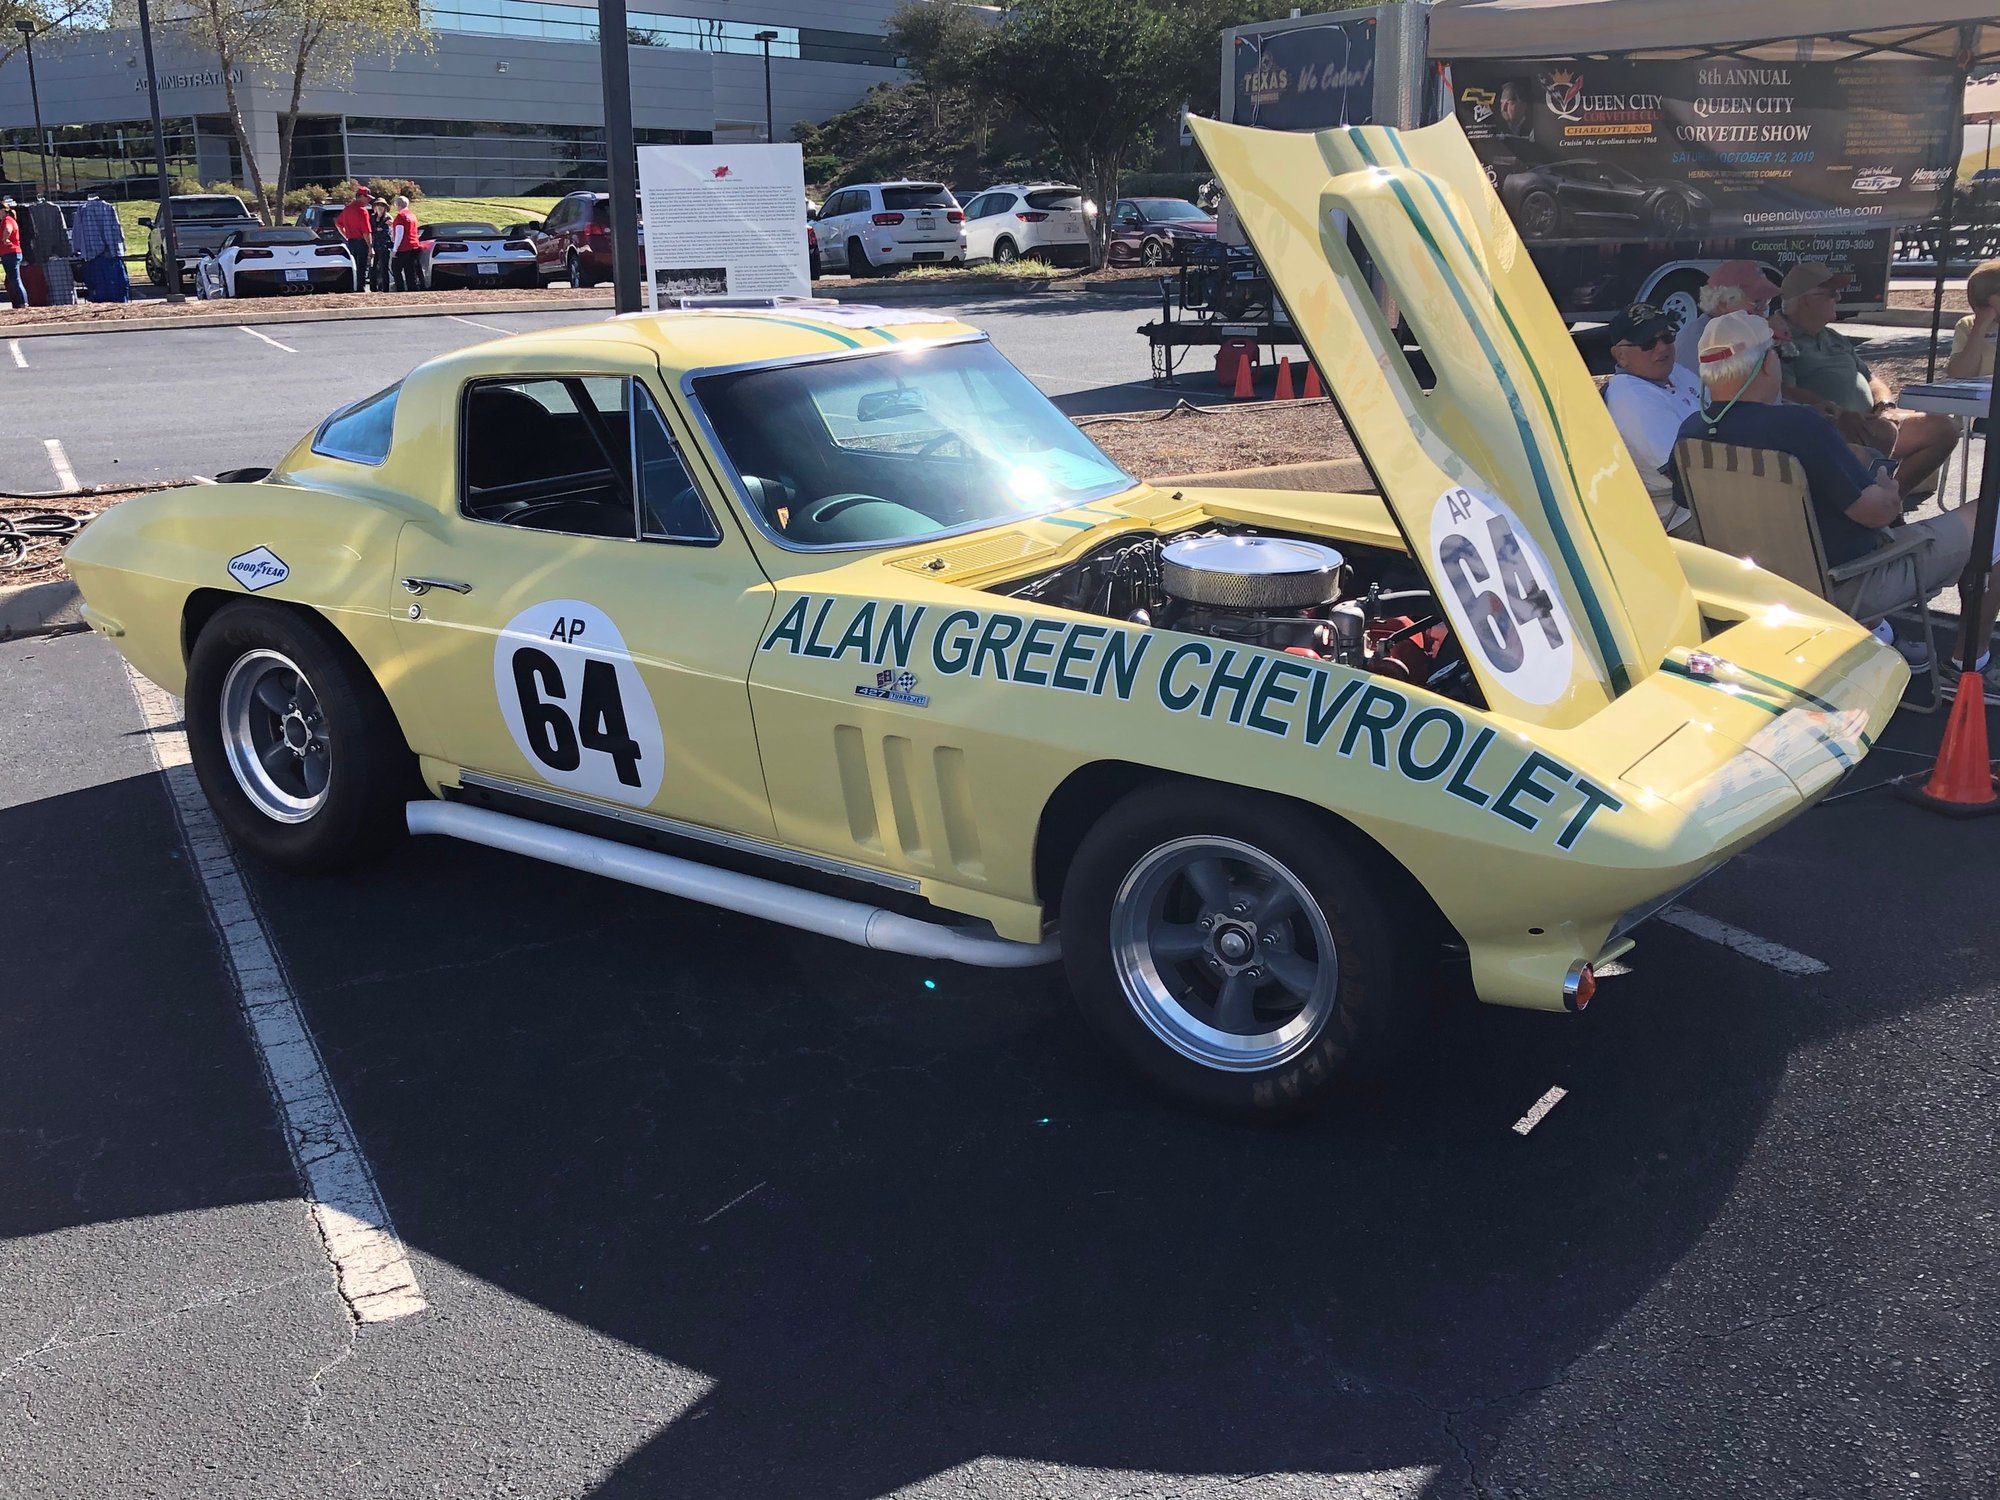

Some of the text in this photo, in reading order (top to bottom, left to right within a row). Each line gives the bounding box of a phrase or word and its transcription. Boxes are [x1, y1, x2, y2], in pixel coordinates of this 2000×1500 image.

[135, 69, 243, 91] ADINISTRATIN
[1244, 70, 1288, 93] TEXAS
[1298, 63, 1318, 92] We
[1698, 68, 1792, 86] 8th ANNUAL
[1546, 83, 1663, 122] QUEEN CITY
[1693, 97, 1795, 118] QUEEN CITY
[1566, 125, 1651, 136] CHARLOTTE, NC
[1676, 125, 1811, 142] CORVETTE SHOW
[1585, 138, 1596, 146] the
[1720, 151, 1772, 163] OCTOBER
[1775, 151, 1787, 164] 12,
[1790, 151, 1815, 163] 2019
[1760, 169, 1793, 178] COMPLEX
[1743, 205, 1883, 226] queencitycorvette.com
[1751, 240, 1789, 252] Concord,
[1791, 241, 1806, 251] NC
[1812, 240, 1834, 251] (704)
[1778, 252, 1796, 262] 7801
[1830, 252, 1848, 262] Lane
[1446, 489, 1472, 525] AP
[1439, 513, 1564, 674] 64
[550, 617, 586, 644] AP
[859, 688, 887, 697] 427
[512, 647, 642, 788] 64
[761, 595, 1624, 853] ALAN GREEN CHEVROLET
